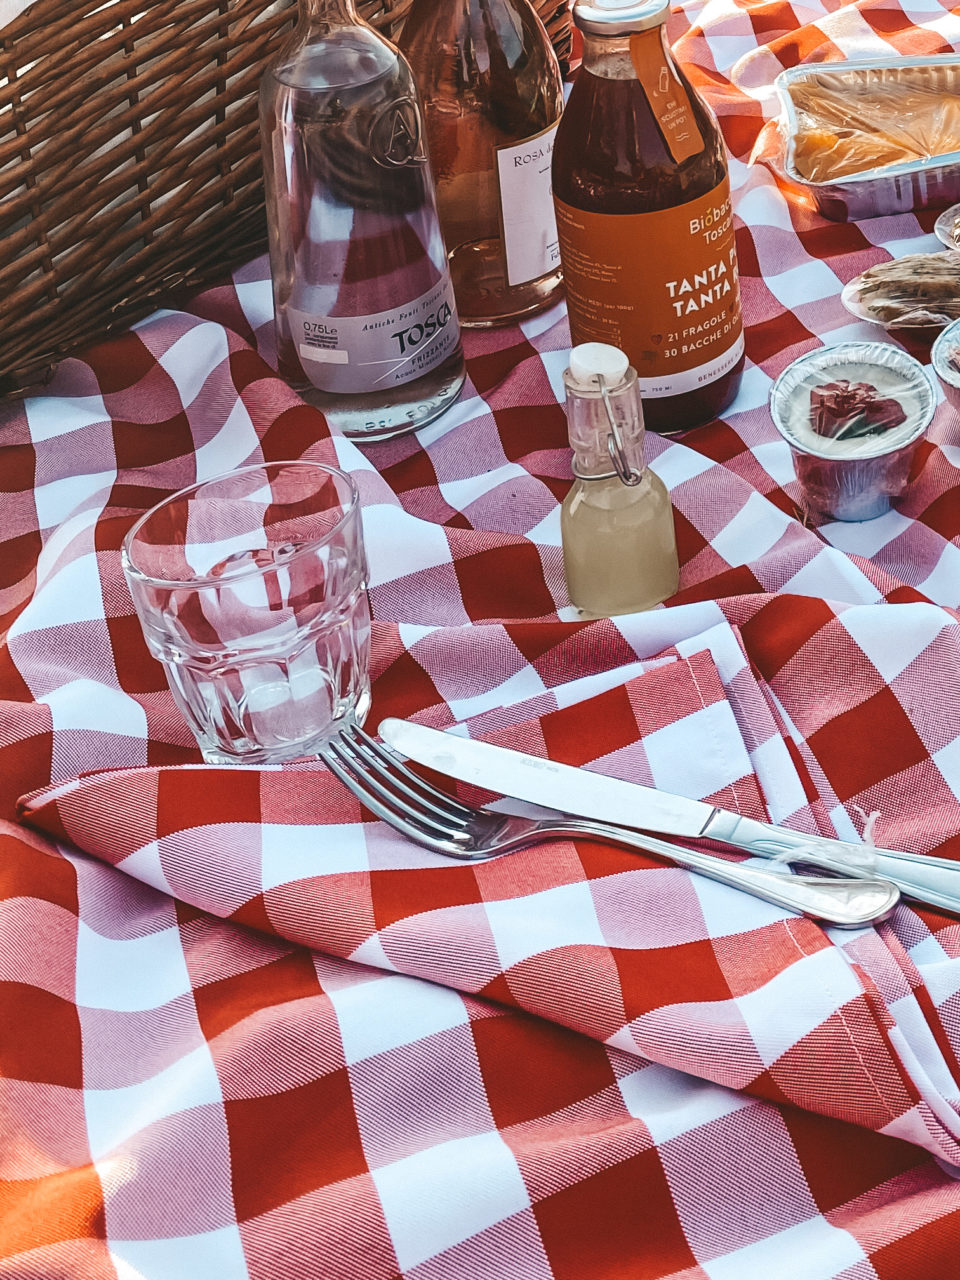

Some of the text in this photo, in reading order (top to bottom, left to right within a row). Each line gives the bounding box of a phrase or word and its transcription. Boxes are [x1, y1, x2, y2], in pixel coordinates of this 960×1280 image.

[513, 149, 544, 168] ROSA
[665, 260, 727, 298] TANTA
[672, 278, 731, 317] TANTA
[362, 317, 395, 332] Antiche
[399, 307, 419, 321] Fonti
[391, 301, 452, 355] TOSCA
[667, 310, 727, 342] 21 FRAGOLE
[411, 334, 450, 366] FRIZZANTE
[664, 348, 678, 358] 30
[682, 329, 722, 354] BACCHE
[723, 321, 732, 334] DI
